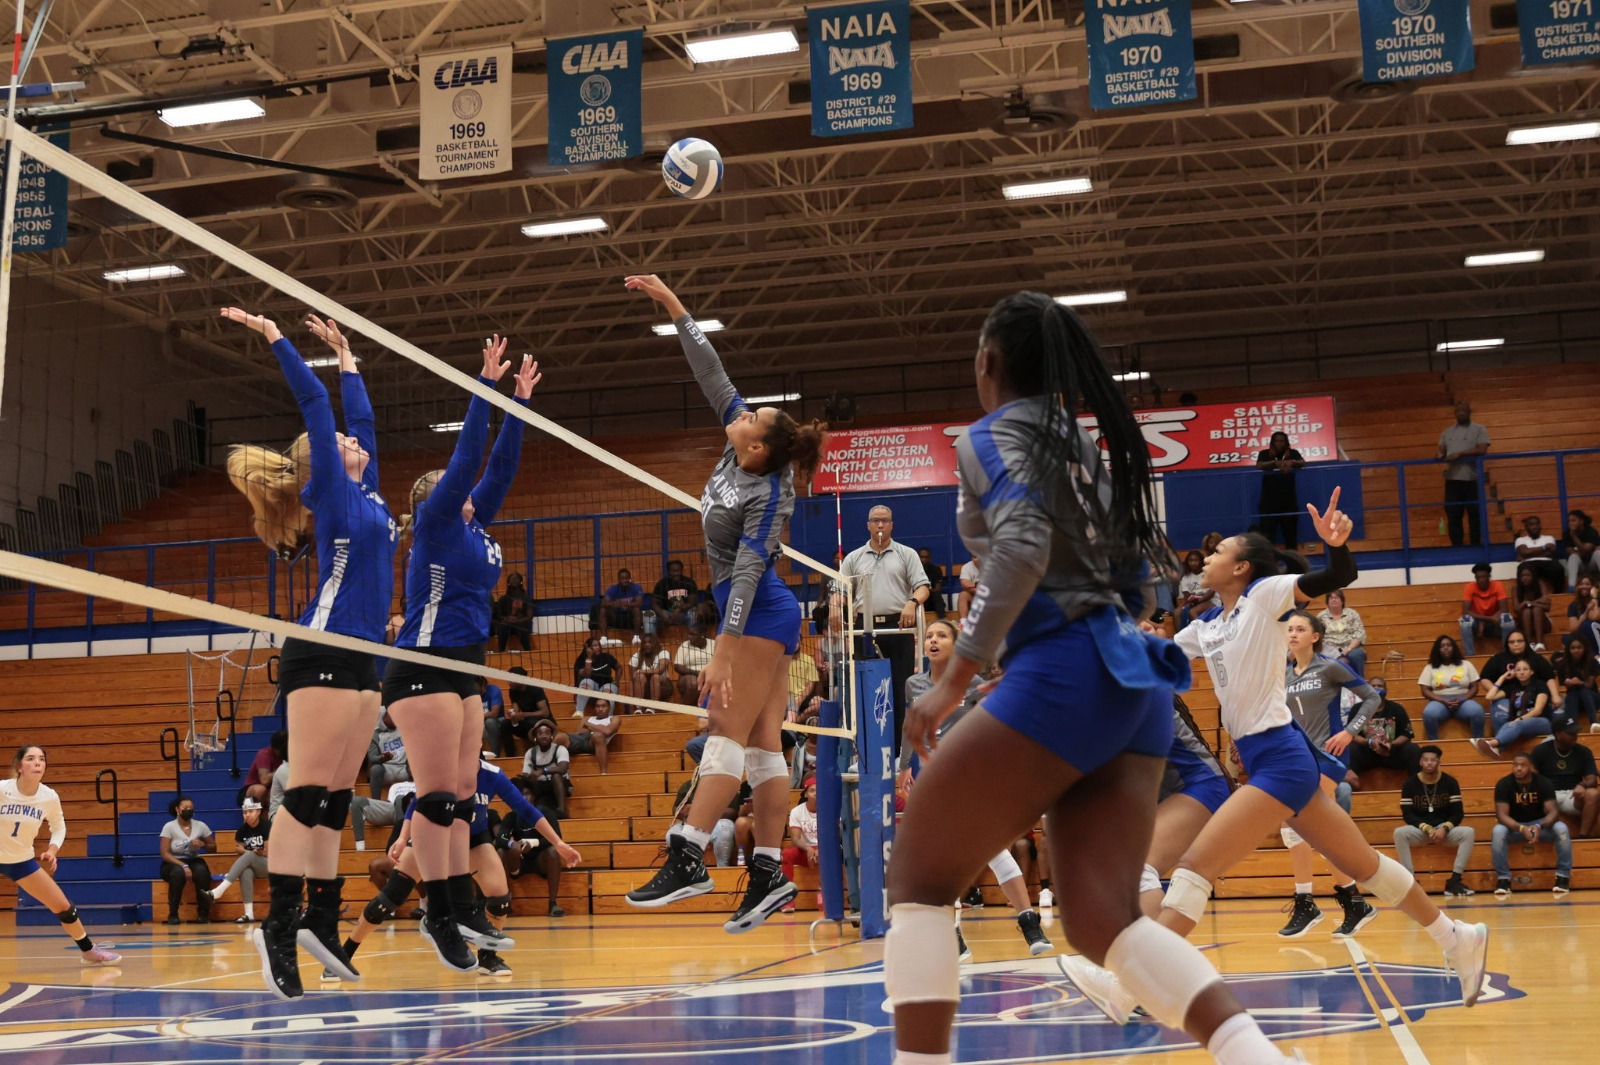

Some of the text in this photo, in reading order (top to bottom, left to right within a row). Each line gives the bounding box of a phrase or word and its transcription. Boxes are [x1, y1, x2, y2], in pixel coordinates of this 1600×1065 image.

[1549, 0, 1592, 19] 1971
[821, 11, 897, 41] NAIA
[1102, 7, 1173, 44] NAIA
[1392, 15, 1436, 36] 1970
[1535, 22, 1588, 37] DISTRICT
[1375, 33, 1445, 50] SOUTHERN
[1537, 32, 1600, 48] BASKETBA
[561, 40, 628, 75] CIAA
[828, 40, 896, 76] NAIA
[1120, 45, 1162, 66] 1970
[1386, 48, 1442, 64] DIVISION
[433, 56, 498, 90] CIAA
[1105, 67, 1179, 83] DISTRICT #29
[1377, 61, 1453, 79] CHAMPIONS
[840, 72, 882, 91] 1969
[1107, 77, 1179, 94] BASKETBALL
[826, 94, 896, 110] DISTRICT #29
[1111, 89, 1176, 104] CHAMPIONS
[577, 105, 616, 126] 1969
[827, 105, 895, 120] BASKETBALL
[449, 121, 486, 140] 1969
[570, 123, 624, 137] SOUTHERN
[831, 116, 893, 131] CHAMPIONS
[436, 139, 498, 153] BASKETBALL
[565, 140, 629, 155] BASKETBALL
[576, 133, 619, 146] DIVISION
[435, 149, 500, 163] TOURNAMENT
[569, 149, 627, 163] CHAMPIONS
[439, 160, 496, 174] CHAMPIONS
[684, 322, 707, 346] ECSU
[1234, 403, 1297, 417] SALES
[1222, 413, 1310, 428] SERVICE
[1209, 422, 1323, 439] BODY SHOP
[850, 434, 906, 448] SERVING
[1235, 434, 1299, 449] PARS
[827, 444, 929, 461] NORTHEASTERN
[820, 455, 934, 473] NORTH CAROLINA
[842, 469, 912, 484] SINCE 1982
[729, 597, 745, 626] ECSU
[1211, 650, 1228, 688] 6
[1295, 696, 1304, 715] 1
[0, 804, 43, 820] CHOWAN
[11, 822, 20, 837] 1
